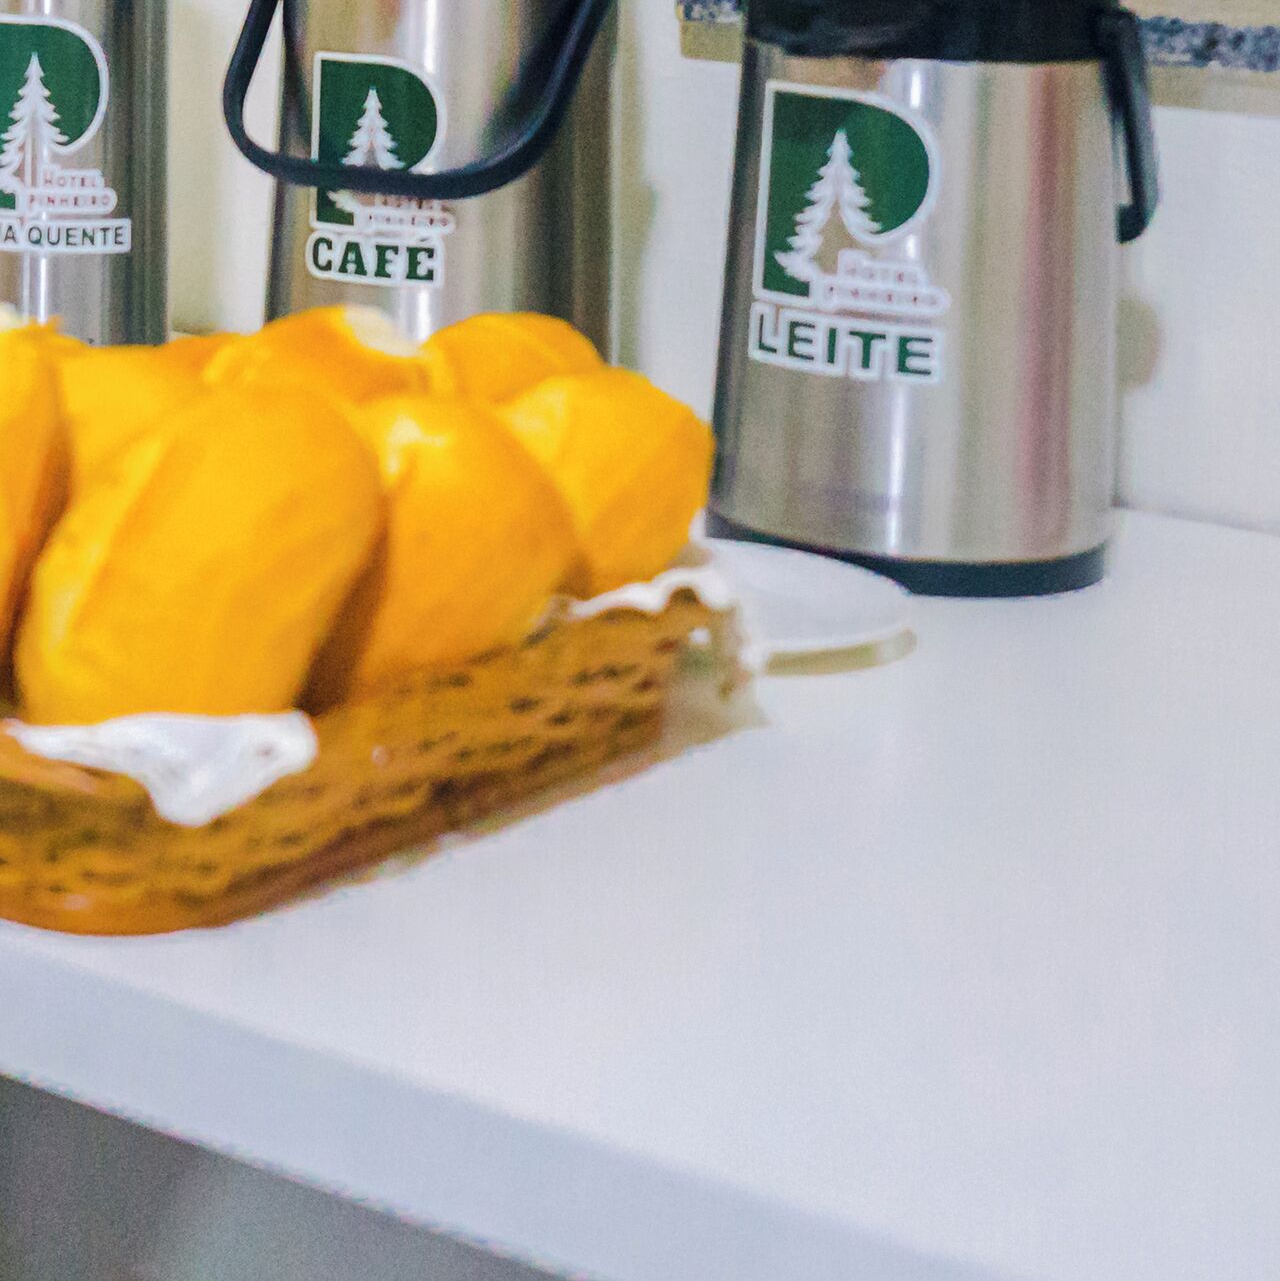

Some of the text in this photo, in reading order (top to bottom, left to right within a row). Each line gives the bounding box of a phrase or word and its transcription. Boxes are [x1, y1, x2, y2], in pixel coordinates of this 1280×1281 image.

[27, 225, 124, 247] QUENTE
[312, 237, 435, 281] CAFÉ
[757, 314, 934, 376] LEITE
